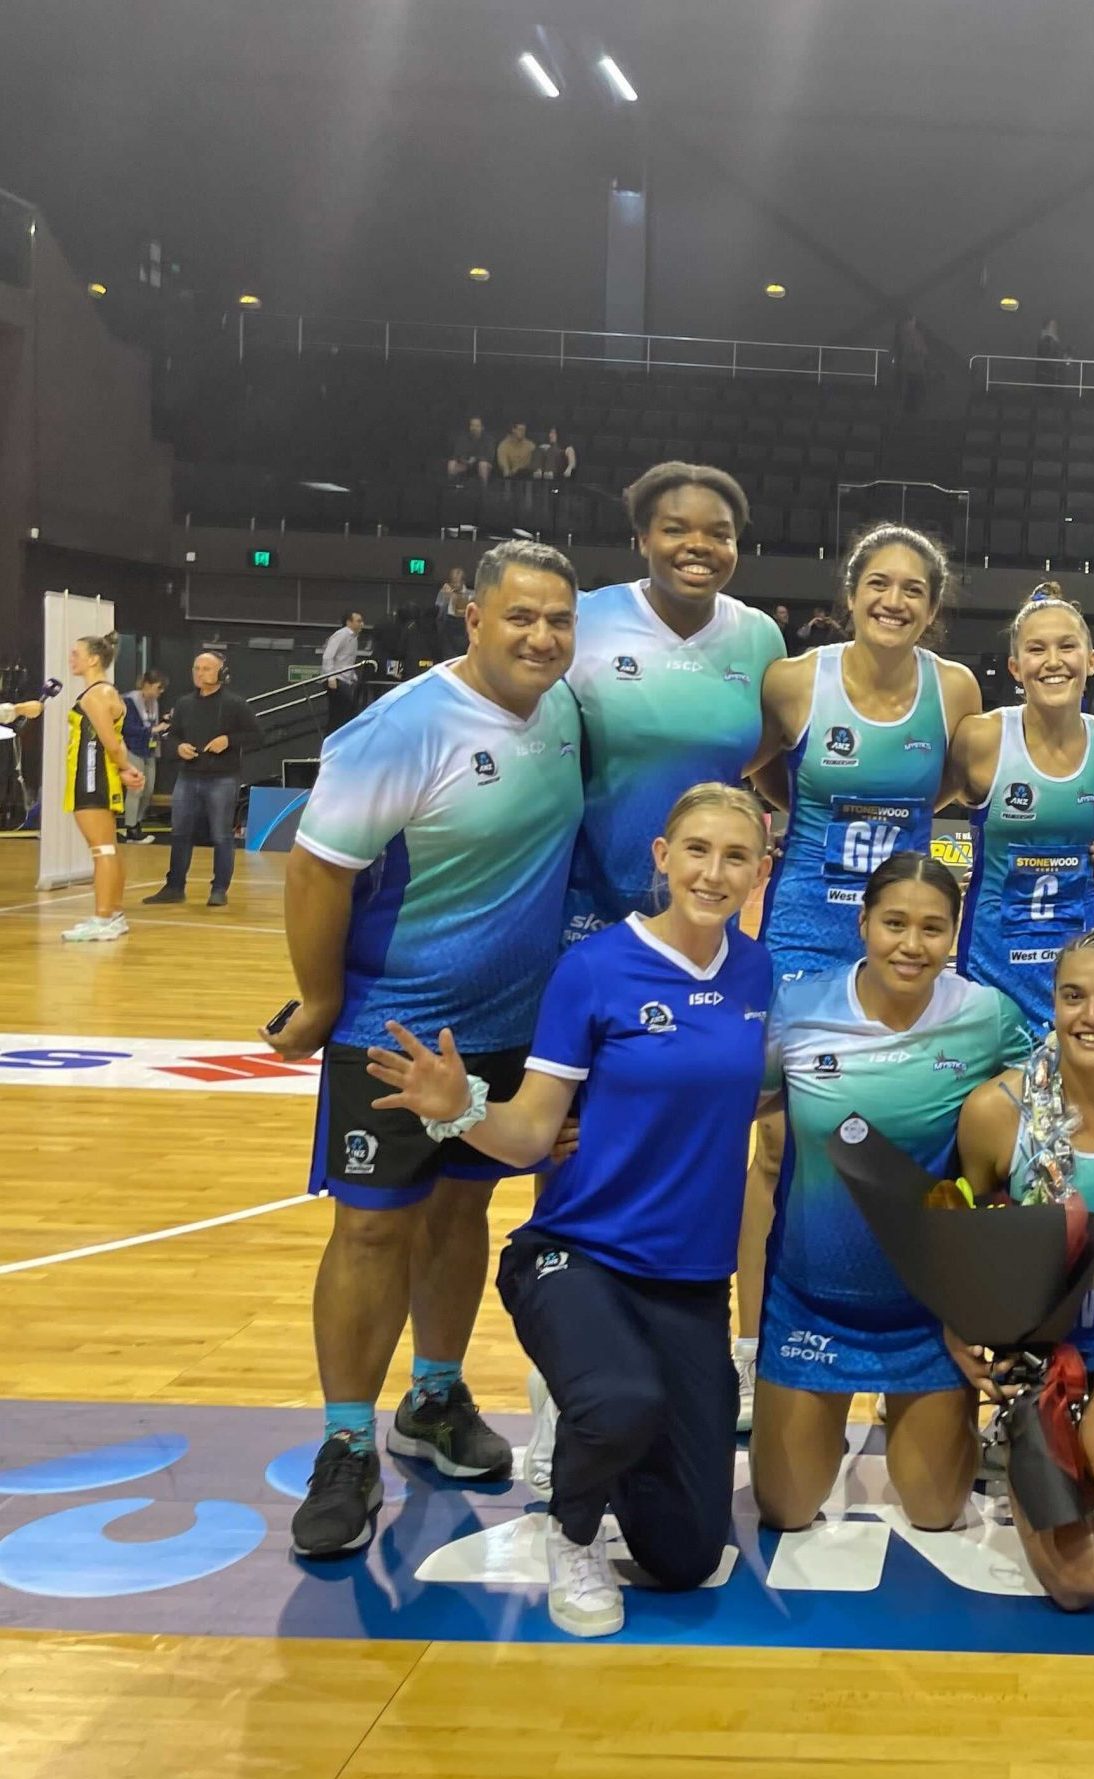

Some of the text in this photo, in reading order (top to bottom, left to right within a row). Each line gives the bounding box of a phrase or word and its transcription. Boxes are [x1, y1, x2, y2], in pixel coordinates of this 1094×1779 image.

[831, 741, 851, 751] ANZ
[1010, 797, 1030, 806] ANZ
[842, 804, 910, 818] STONEWOOD
[1016, 857, 1079, 868] STONEWOOD
[828, 890, 858, 902] West
[1031, 875, 1059, 920] C
[1011, 950, 1037, 961] West
[780, 1345, 839, 1364] SPORT
